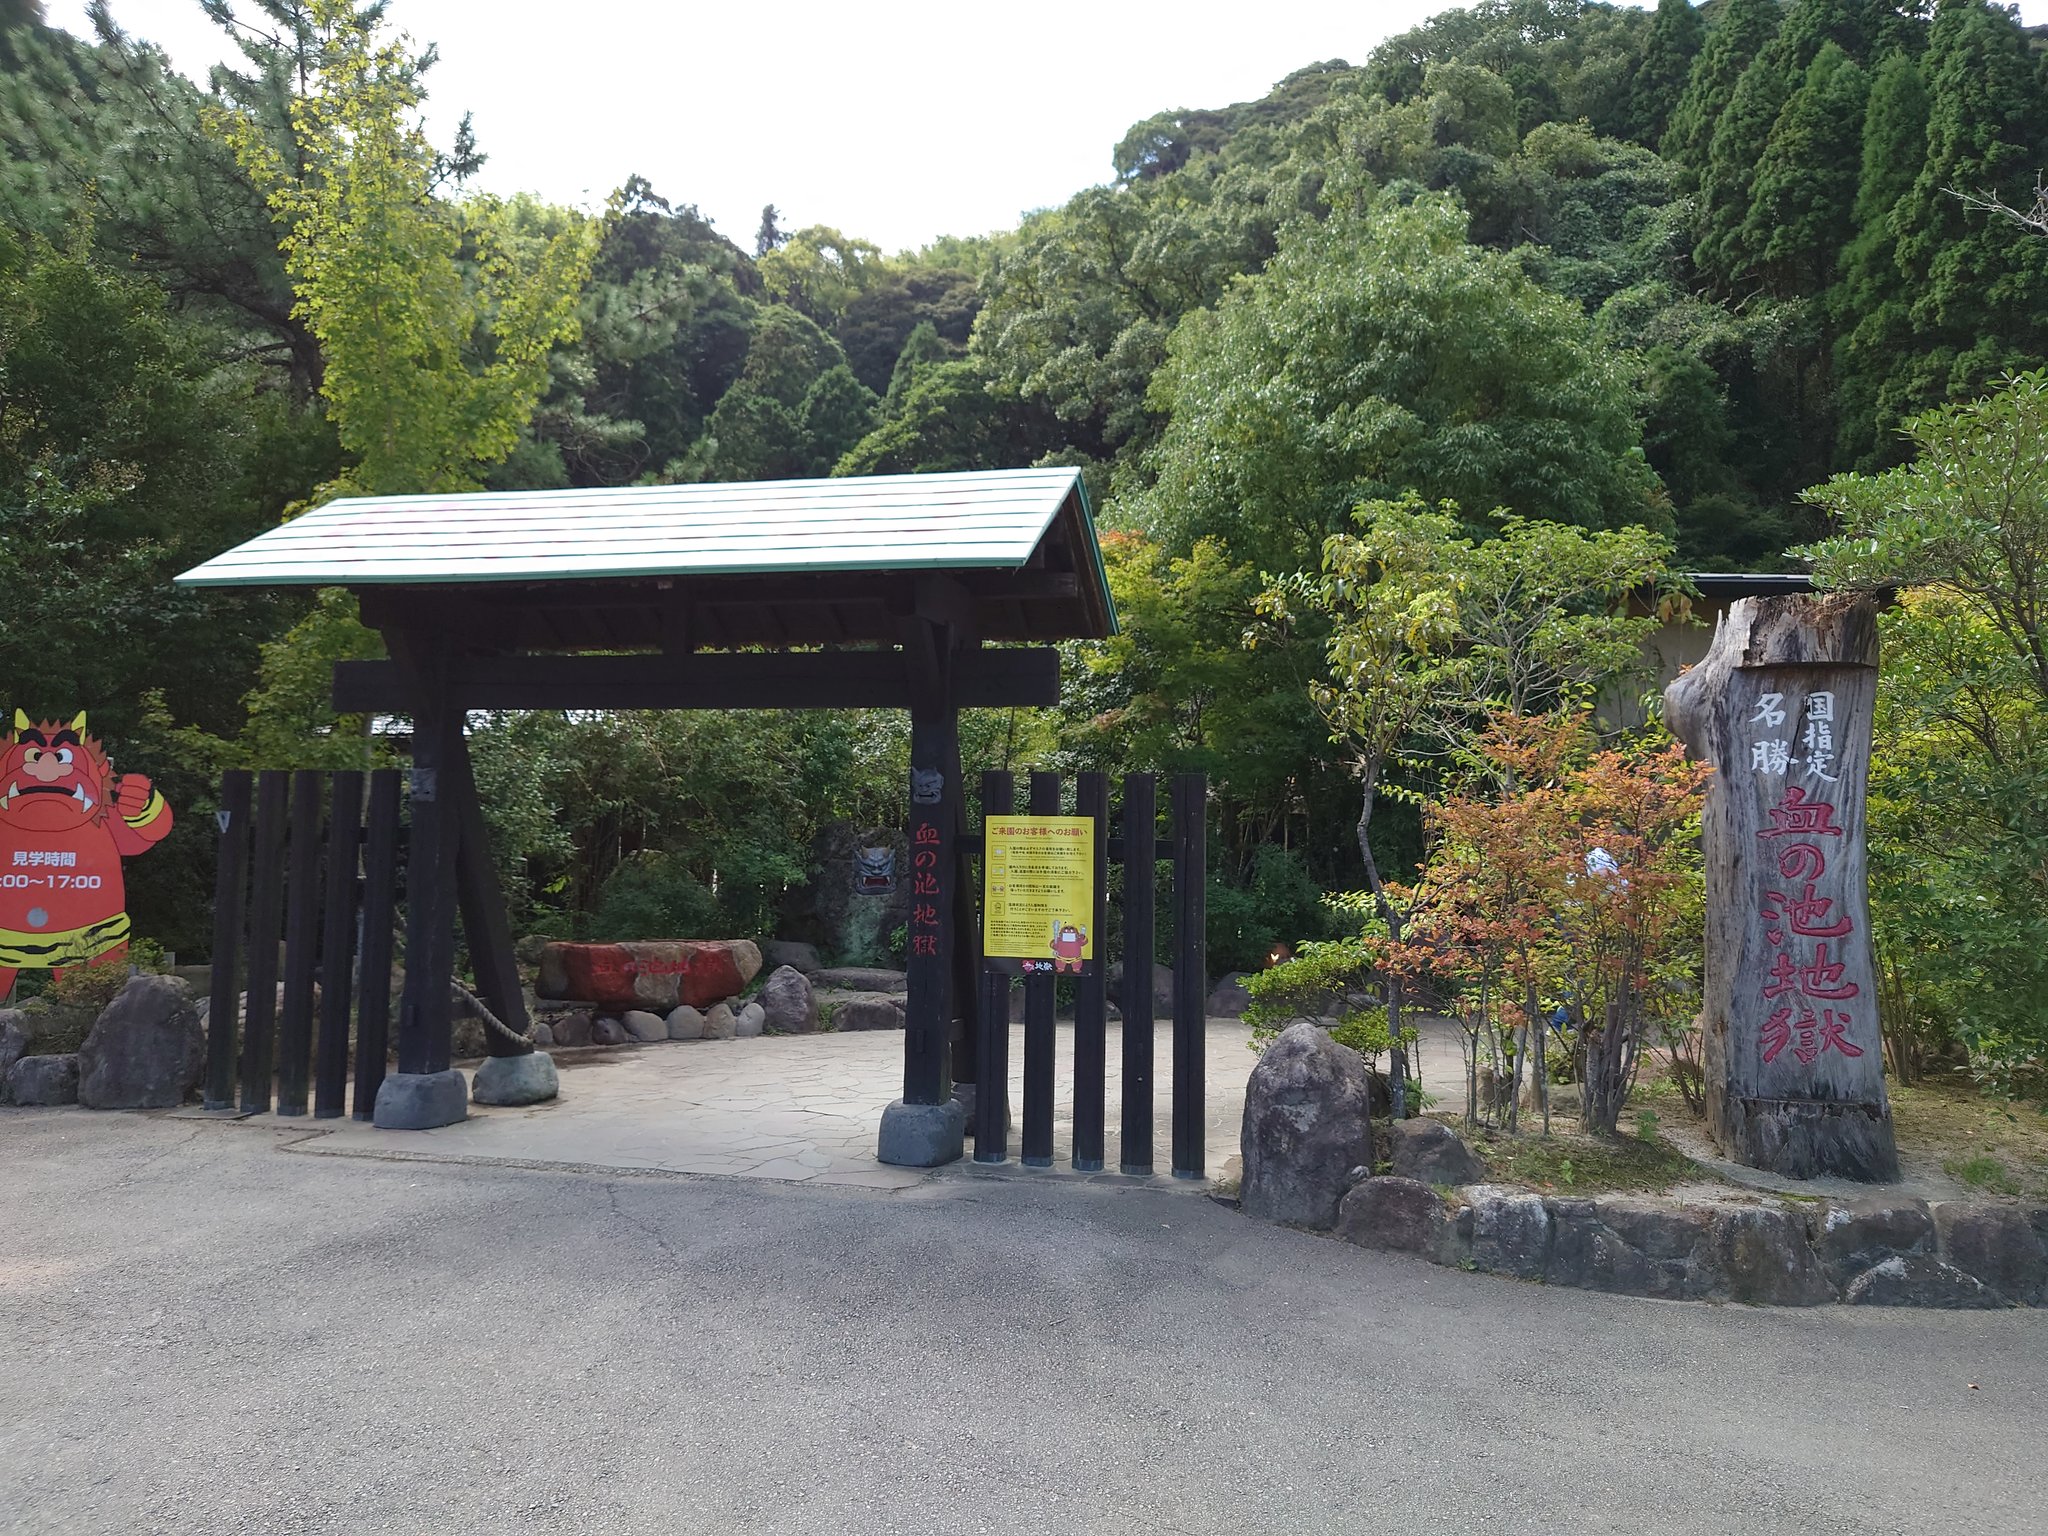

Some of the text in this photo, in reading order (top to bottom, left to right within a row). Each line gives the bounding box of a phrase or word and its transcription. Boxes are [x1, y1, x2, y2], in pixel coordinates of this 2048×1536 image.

[1748, 692, 1799, 775] 名勝
[1802, 691, 1838, 782] 国指定
[12, 851, 77, 867] 見学時間
[991, 827, 1088, 836] ご来園のお客様へのお願い
[912, 822, 941, 955] 血の池地獄
[1755, 785, 1864, 1065] 血の池地獄
